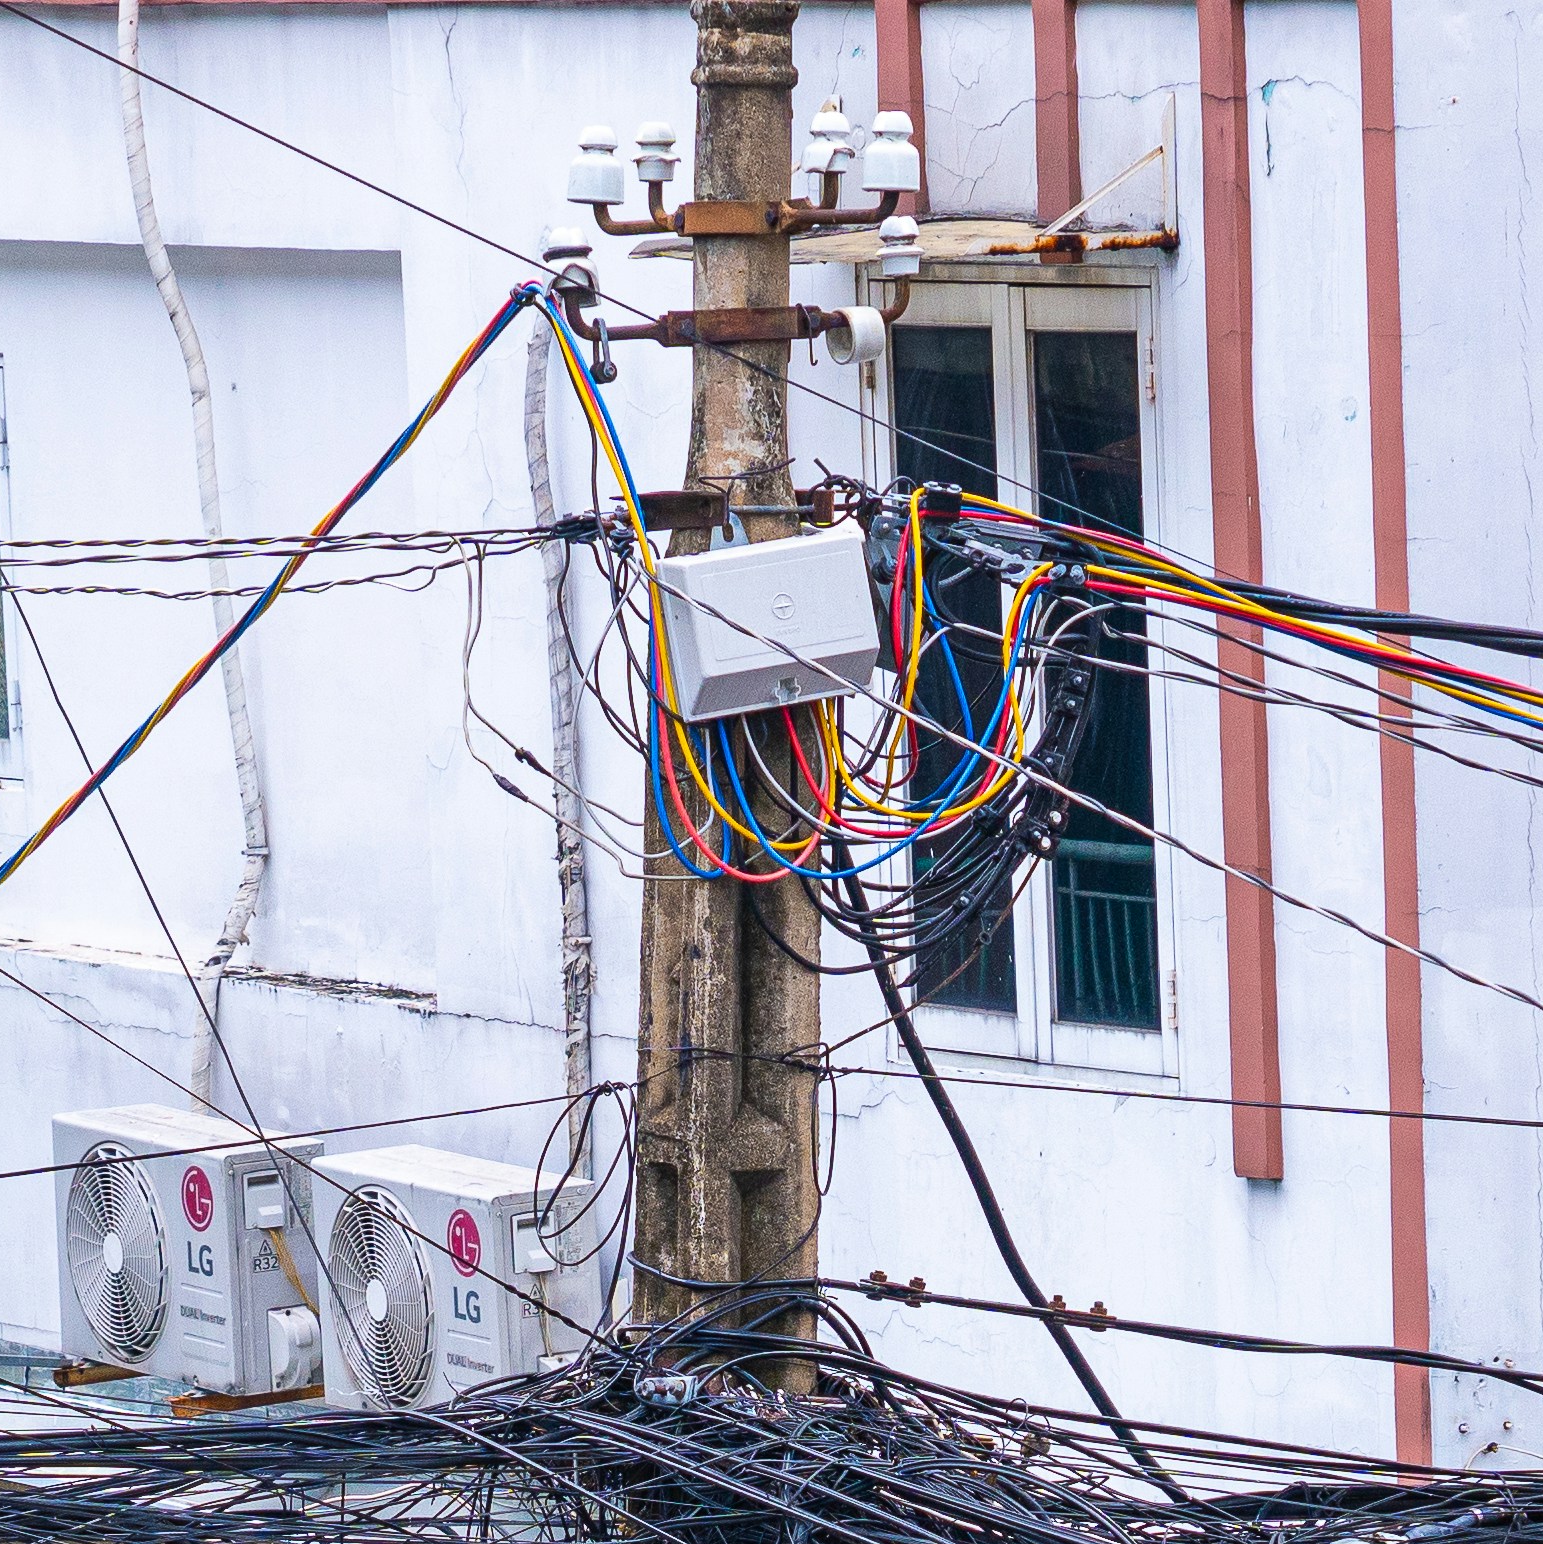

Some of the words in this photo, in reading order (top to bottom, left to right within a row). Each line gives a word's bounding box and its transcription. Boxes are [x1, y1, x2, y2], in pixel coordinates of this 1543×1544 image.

[186, 1240, 214, 1277] LG
[254, 1257, 279, 1272] R32
[453, 1286, 481, 1324] LG
